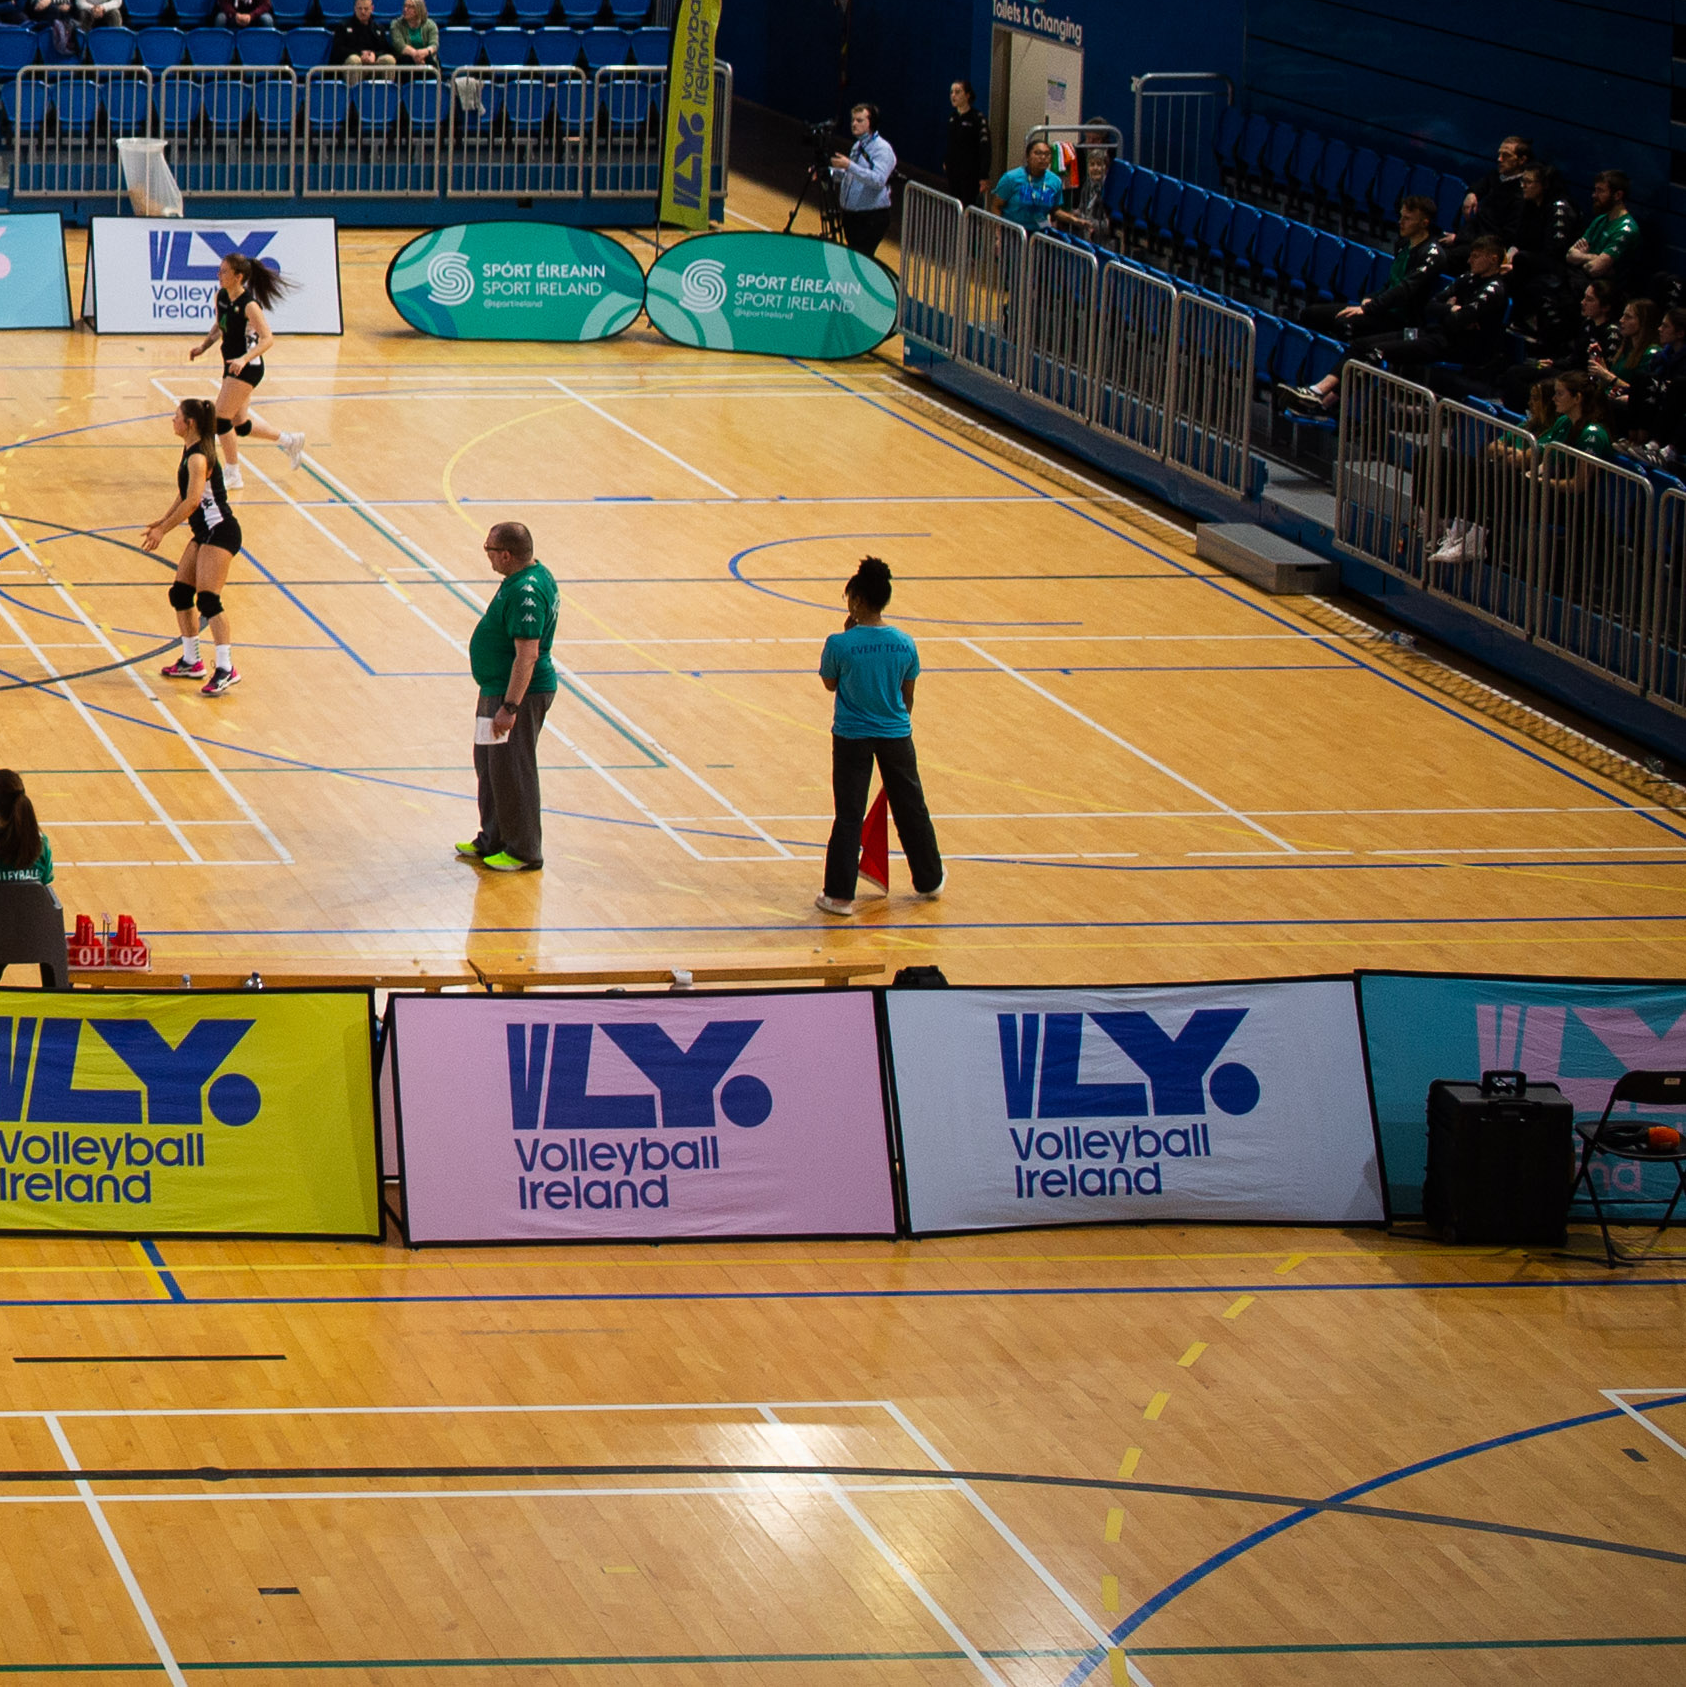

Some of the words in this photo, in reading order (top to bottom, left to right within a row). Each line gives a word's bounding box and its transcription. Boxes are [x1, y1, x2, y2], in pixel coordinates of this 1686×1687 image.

[1023, 5, 1031, 26] &
[1032, 8, 1083, 46] Changing
[692, 20, 711, 106] Ireland
[482, 261, 533, 279] SPÓRT
[536, 260, 606, 279] ÉIREANN
[152, 284, 219, 306] Volley
[482, 281, 532, 296] SPORT
[535, 281, 603, 297] IRELAND
[736, 270, 786, 290] SPÓRT
[790, 274, 862, 296] ÉIREANN
[152, 301, 217, 319] Irelan
[734, 291, 783, 308] SPORT
[787, 296, 856, 314] IRELAND
[850, 644, 881, 655] EVENT
[1009, 1123, 1212, 1165] Volleyball
[515, 1135, 720, 1180] Volleyball
[518, 1174, 670, 1210] Ireland
[1014, 1161, 1164, 1199] Ireland
